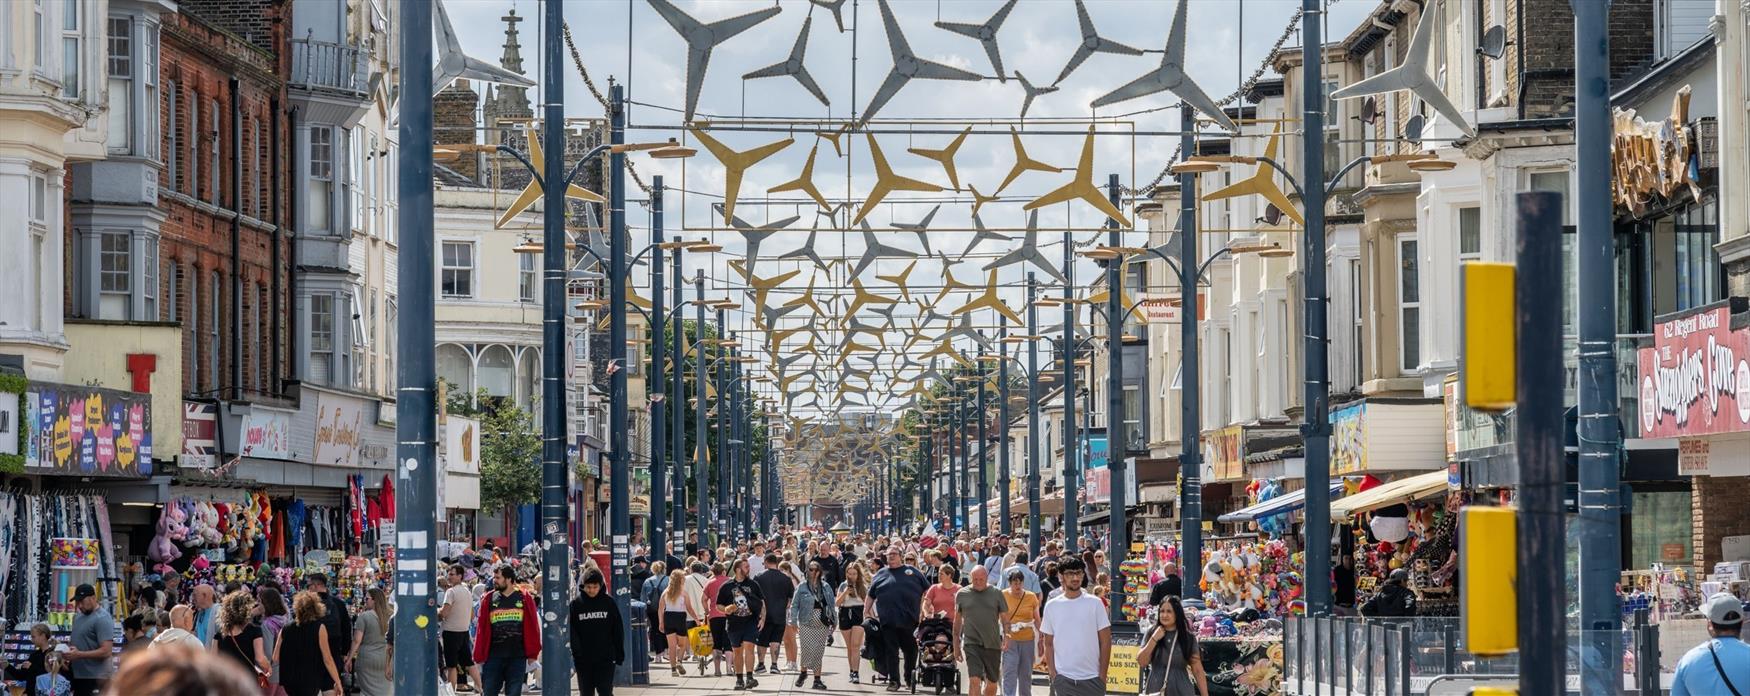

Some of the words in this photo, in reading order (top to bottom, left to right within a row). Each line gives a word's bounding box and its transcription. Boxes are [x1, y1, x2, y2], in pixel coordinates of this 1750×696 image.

[1664, 322, 1673, 338] 62
[1675, 317, 1697, 338] Regent
[1699, 308, 1719, 330] Road
[1662, 345, 1671, 361] THE
[1654, 346, 1704, 425] Smugglers
[1707, 334, 1735, 417] Cove
[578, 611, 608, 621] BLAKELY
[1125, 677, 1139, 685] 5XL
